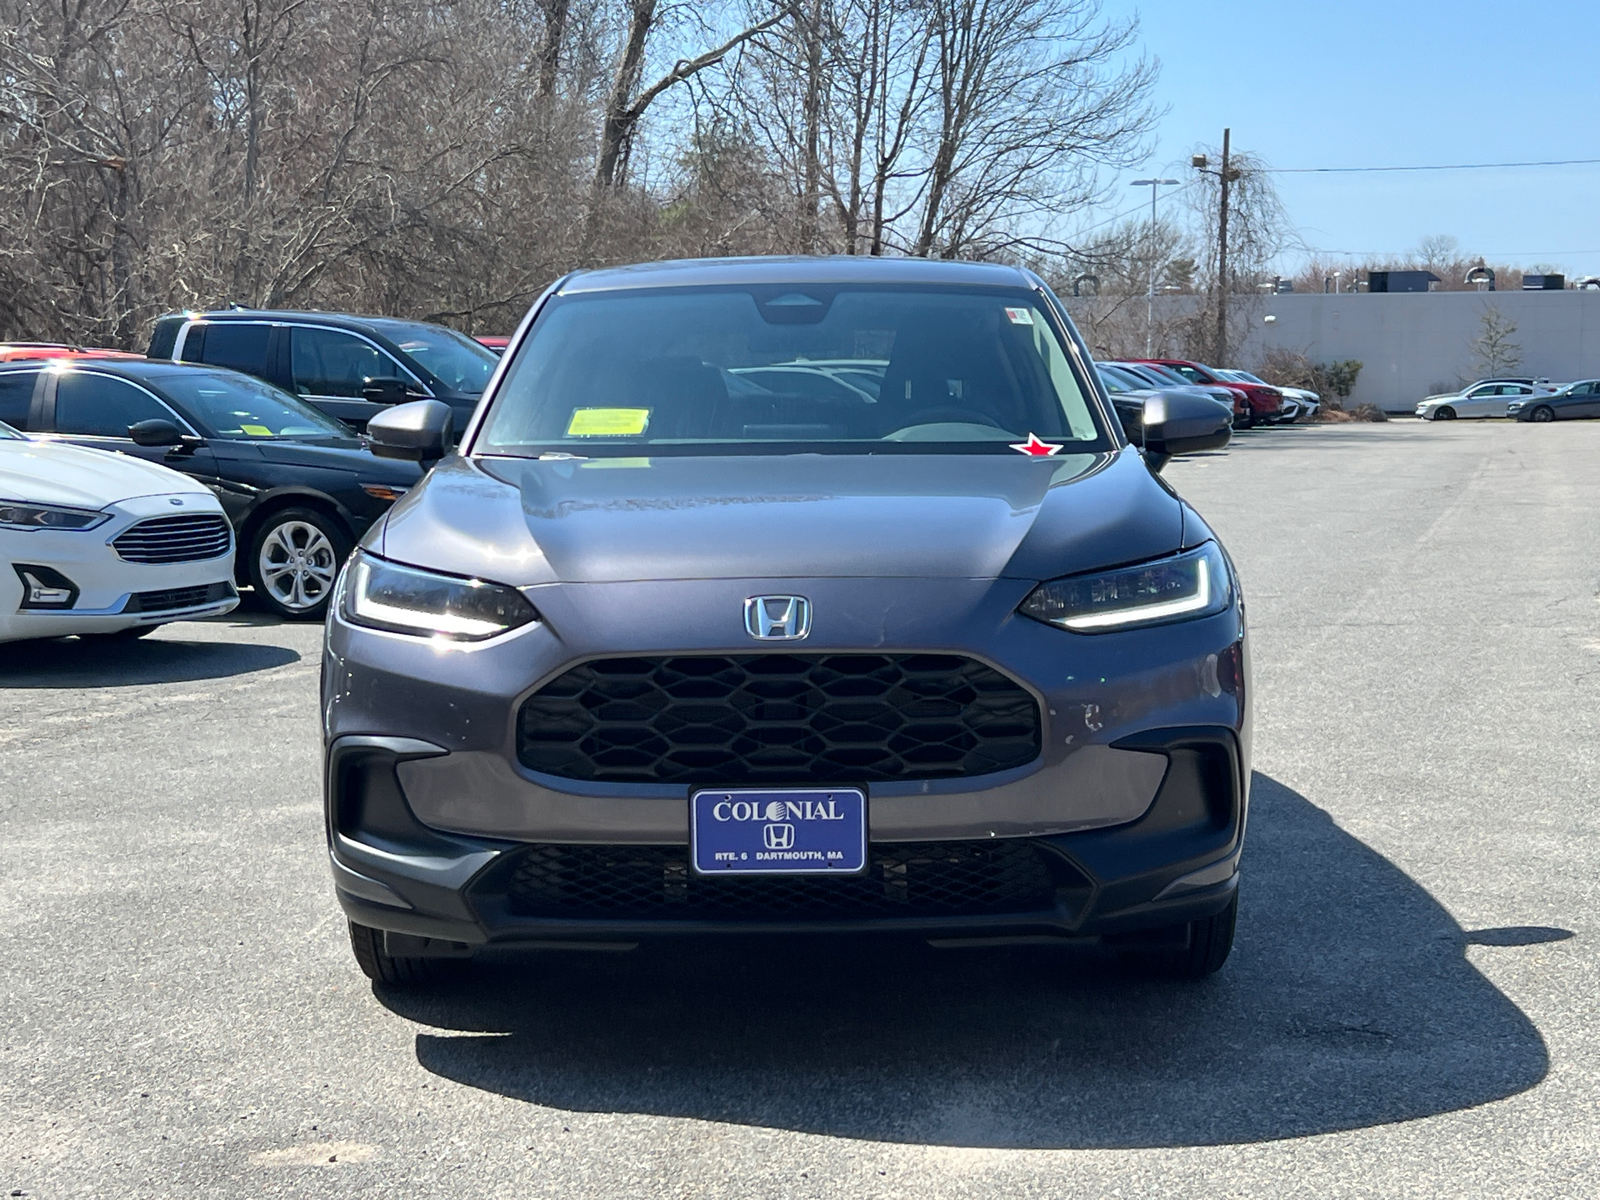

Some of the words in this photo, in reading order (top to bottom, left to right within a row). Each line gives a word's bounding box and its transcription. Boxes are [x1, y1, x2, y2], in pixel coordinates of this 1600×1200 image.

[713, 800, 845, 822] COLONIAL
[715, 852, 739, 861] RTE.
[740, 852, 748, 861] 6
[756, 851, 825, 861] DARTMOUTH,
[827, 851, 844, 860] MA
